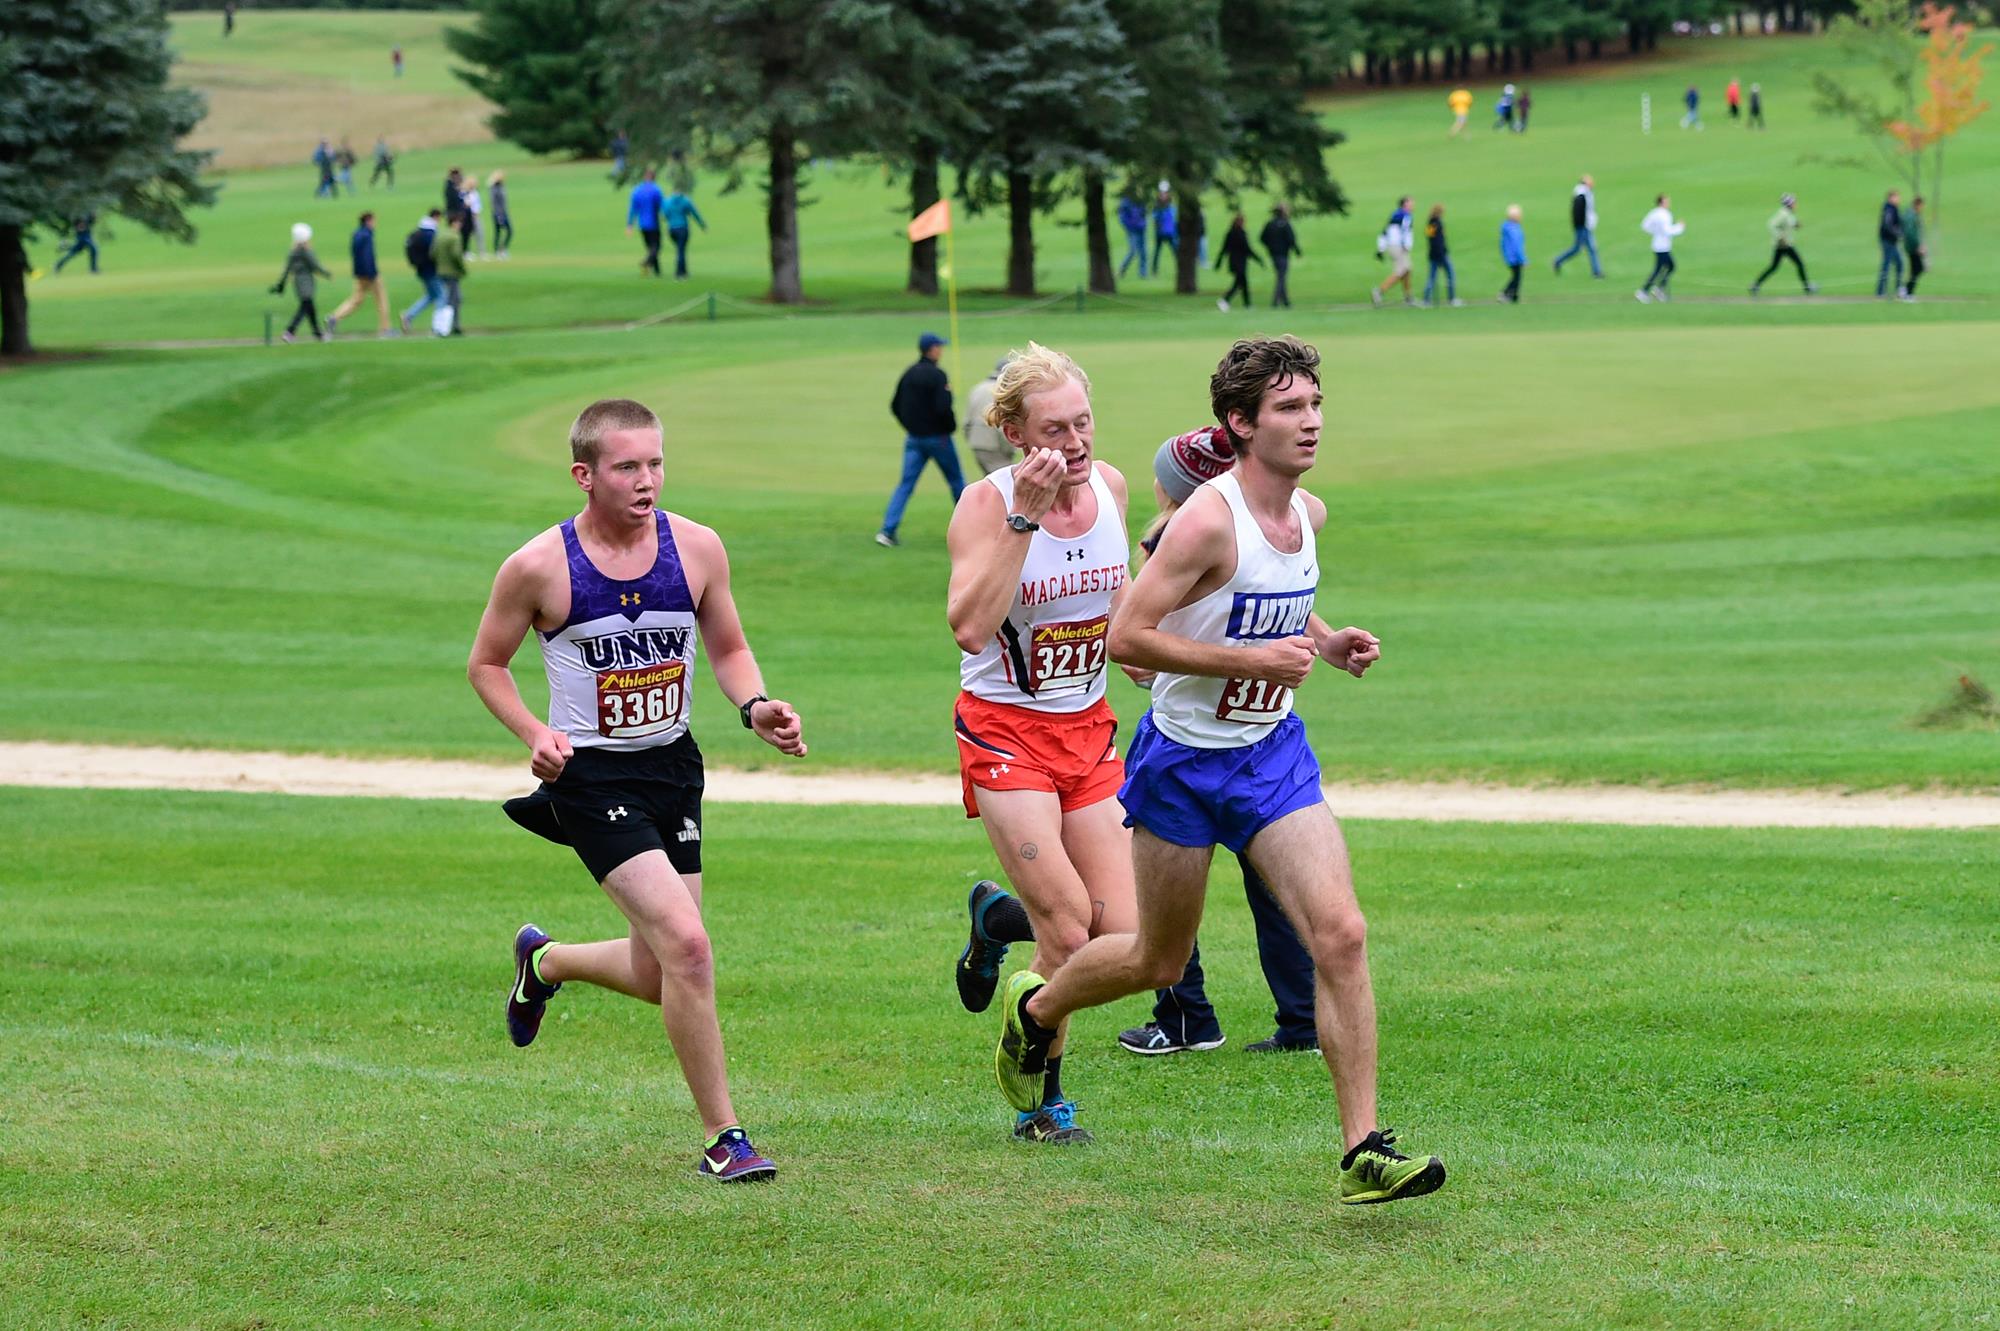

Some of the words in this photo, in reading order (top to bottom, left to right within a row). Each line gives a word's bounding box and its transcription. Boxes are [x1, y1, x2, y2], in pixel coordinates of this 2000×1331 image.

[1239, 592, 1315, 636] LUTH
[571, 627, 691, 674] UNW
[1036, 638, 1104, 680] 3212
[603, 682, 680, 727] 3360
[1227, 677, 1288, 710] 317
